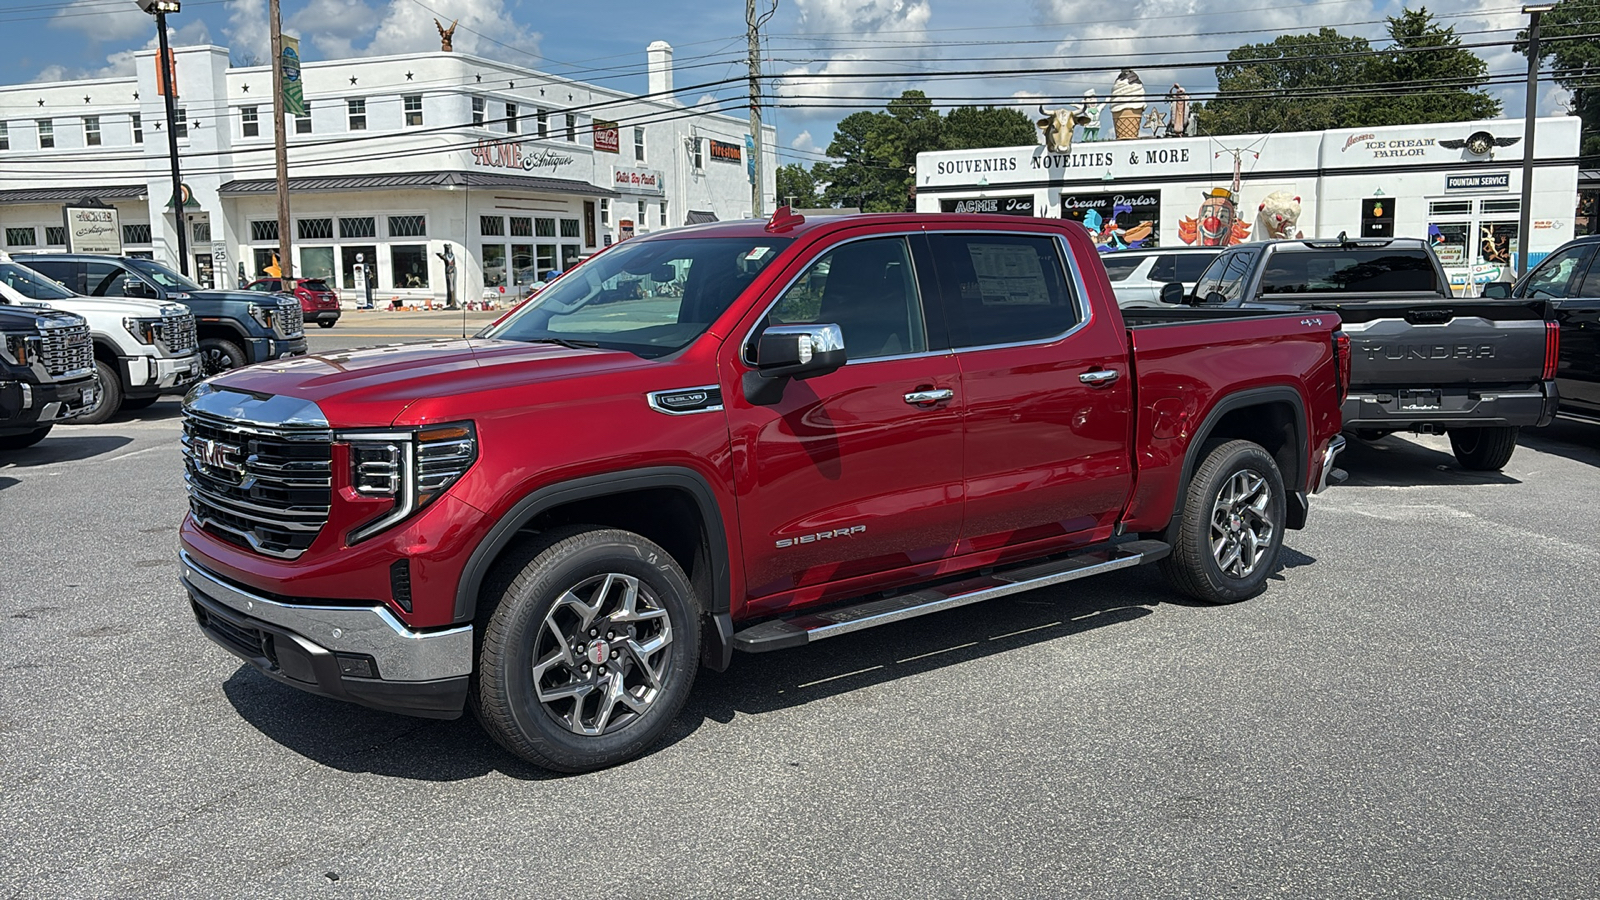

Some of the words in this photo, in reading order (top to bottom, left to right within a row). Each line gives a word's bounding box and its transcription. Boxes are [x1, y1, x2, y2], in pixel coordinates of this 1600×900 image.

[710, 139, 741, 160] Firestone
[1365, 141, 1386, 149] ICE
[1388, 138, 1436, 148] CREAM
[471, 137, 523, 169] ACME
[1373, 148, 1425, 158] PARLOR
[937, 157, 1017, 175] SOUVENIRS
[1032, 152, 1113, 169] NOVELTIES
[1129, 151, 1139, 165] &
[1145, 148, 1190, 164] MORE
[615, 170, 630, 183] Dutch
[631, 172, 641, 186] Boy
[641, 173, 656, 186] Paints
[1449, 178, 1480, 187] FOUNTAIN
[1481, 176, 1507, 185] SERVICE
[955, 200, 998, 213] ACME
[1006, 198, 1032, 211] Ice
[1064, 196, 1107, 209] Cream
[1113, 194, 1158, 206] Parlor
[214, 251, 226, 260] 25
[1362, 344, 1495, 360] TUNDRA
[192, 436, 242, 472] GMC
[775, 525, 867, 549] SIERRA
[506, 574, 552, 658] BRIDGESTONE
